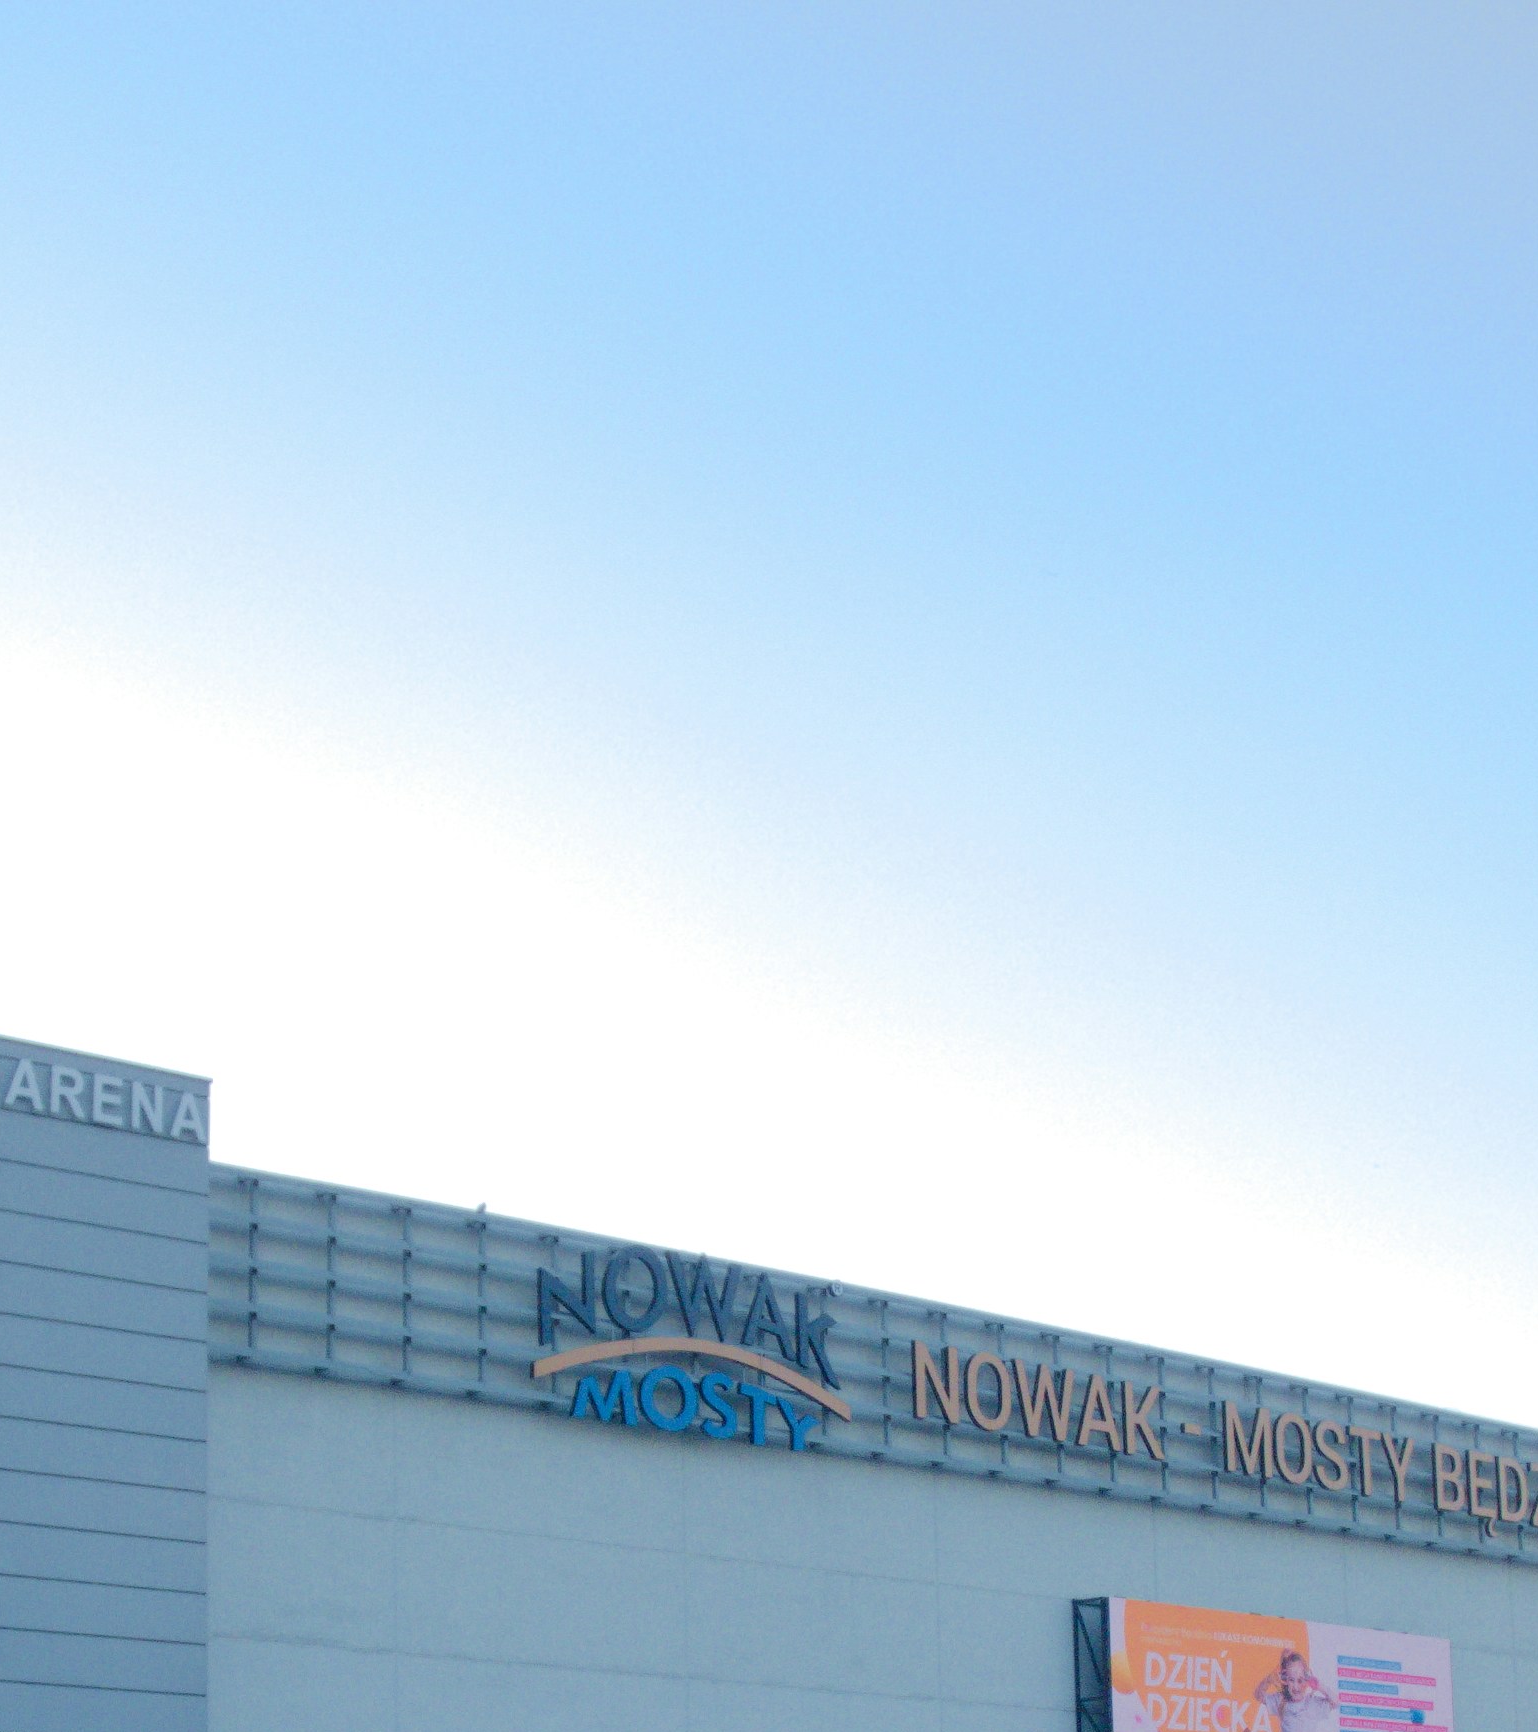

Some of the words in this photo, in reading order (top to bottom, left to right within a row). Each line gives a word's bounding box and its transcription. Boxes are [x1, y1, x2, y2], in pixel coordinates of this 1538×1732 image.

[4, 1057, 209, 1143] ARENA
[536, 1244, 841, 1390] NOWAK
[569, 1364, 821, 1452] MOSTY
[911, 1339, 1165, 1462] NOWAK
[1223, 1399, 1415, 1504] MOSTY
[1144, 1650, 1233, 1694] DZIEŃ
